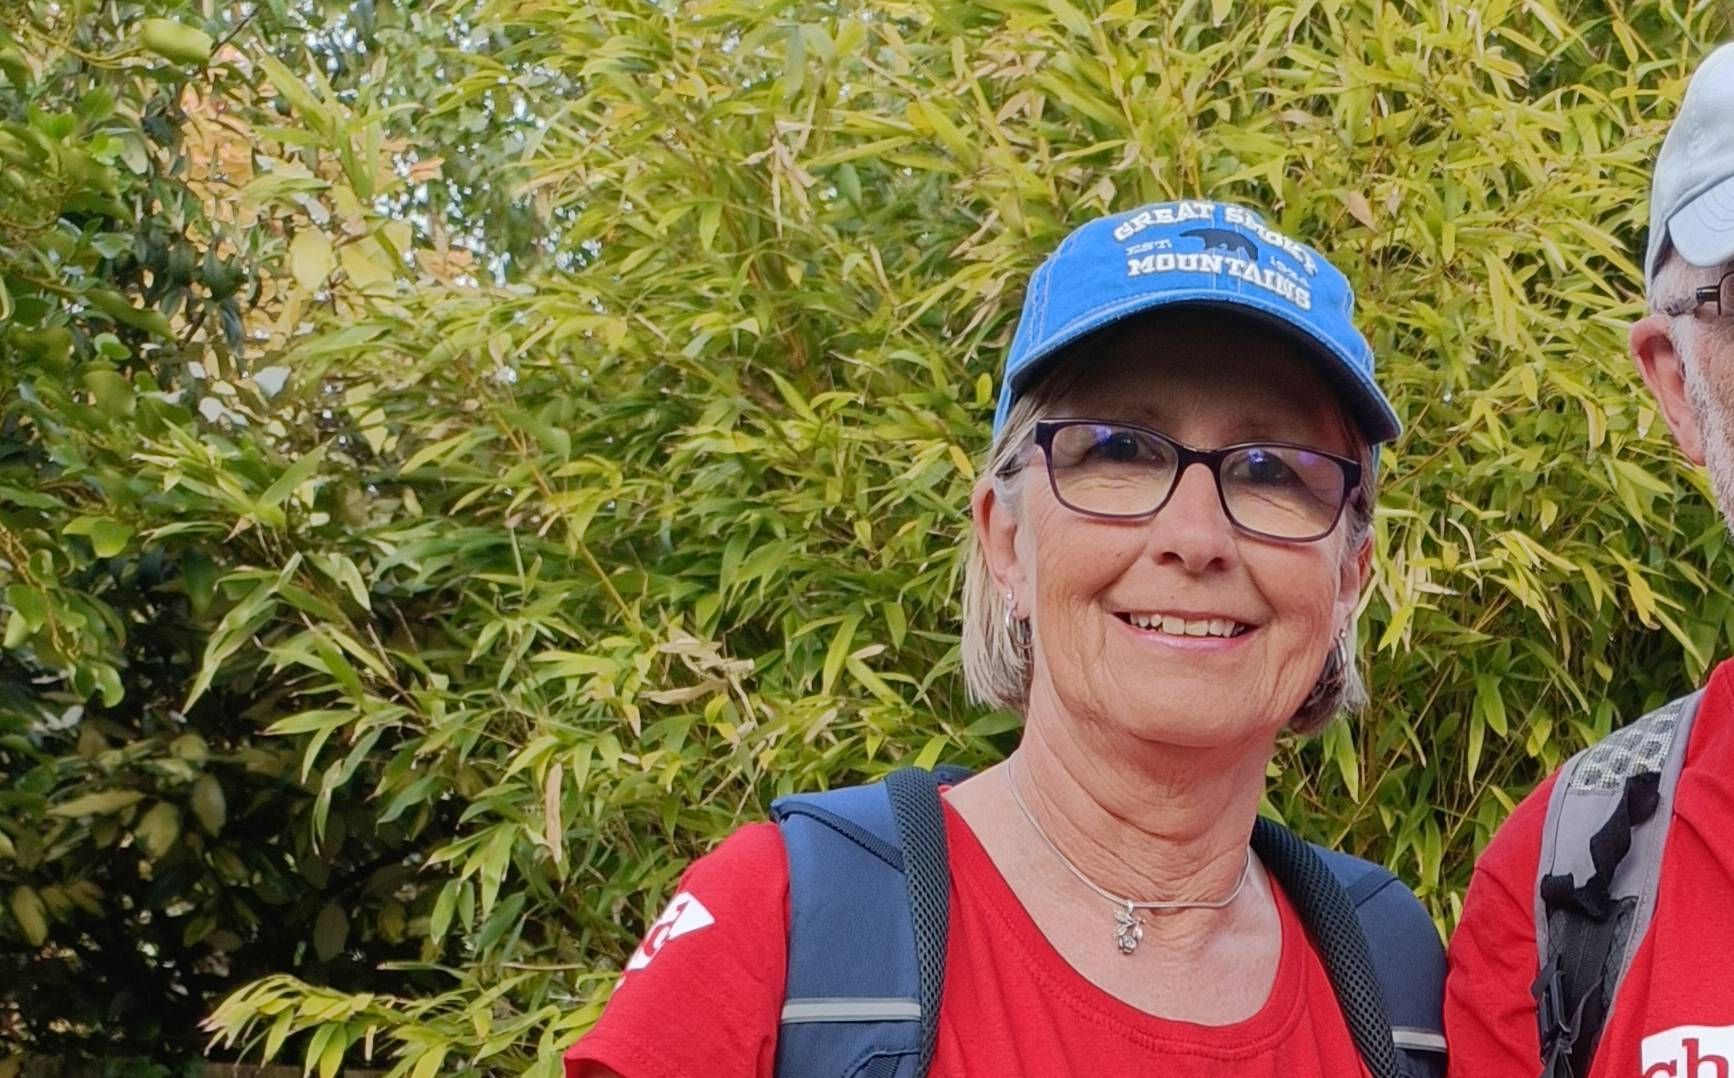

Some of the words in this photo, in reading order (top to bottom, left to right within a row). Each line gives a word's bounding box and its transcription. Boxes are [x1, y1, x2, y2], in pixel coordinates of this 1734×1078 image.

[1113, 202, 1215, 241] GREAT
[1126, 239, 1172, 256] EST.
[1128, 252, 1312, 310] MOUNTAINS
